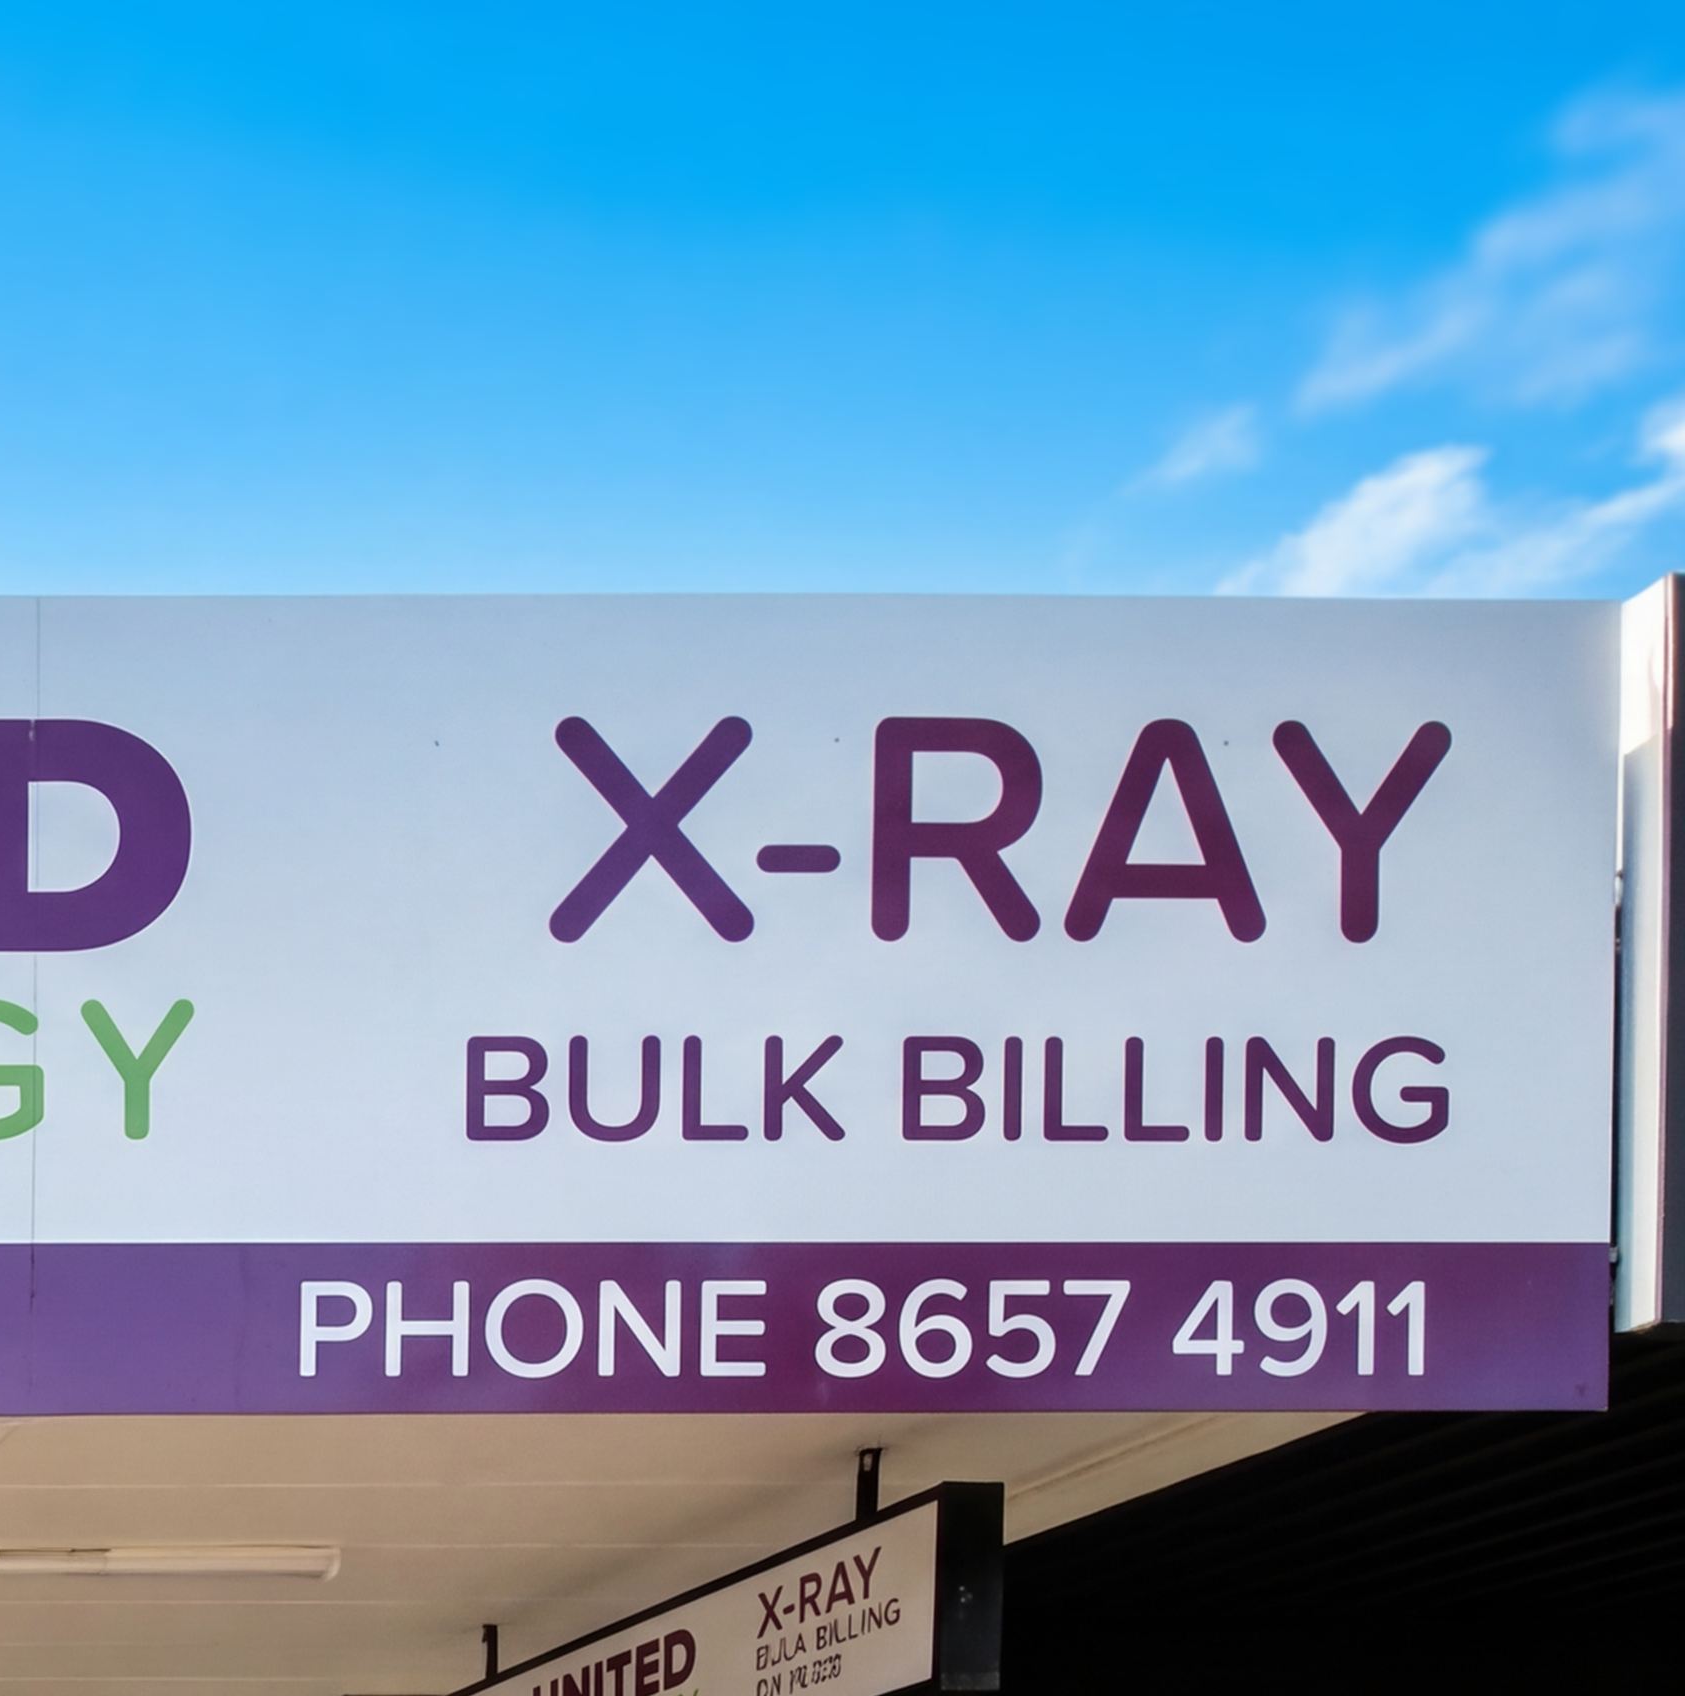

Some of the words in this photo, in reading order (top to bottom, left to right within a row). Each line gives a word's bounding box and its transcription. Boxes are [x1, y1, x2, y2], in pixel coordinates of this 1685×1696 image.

[549, 716, 1452, 943] X-RAY
[466, 1035, 846, 1142] BULK
[900, 1035, 1450, 1144] BILLING
[299, 1280, 766, 1377] PHONE
[814, 1279, 1131, 1378] 8657
[1172, 1279, 1426, 1378] 4911
[757, 1546, 882, 1639] X-RAY
